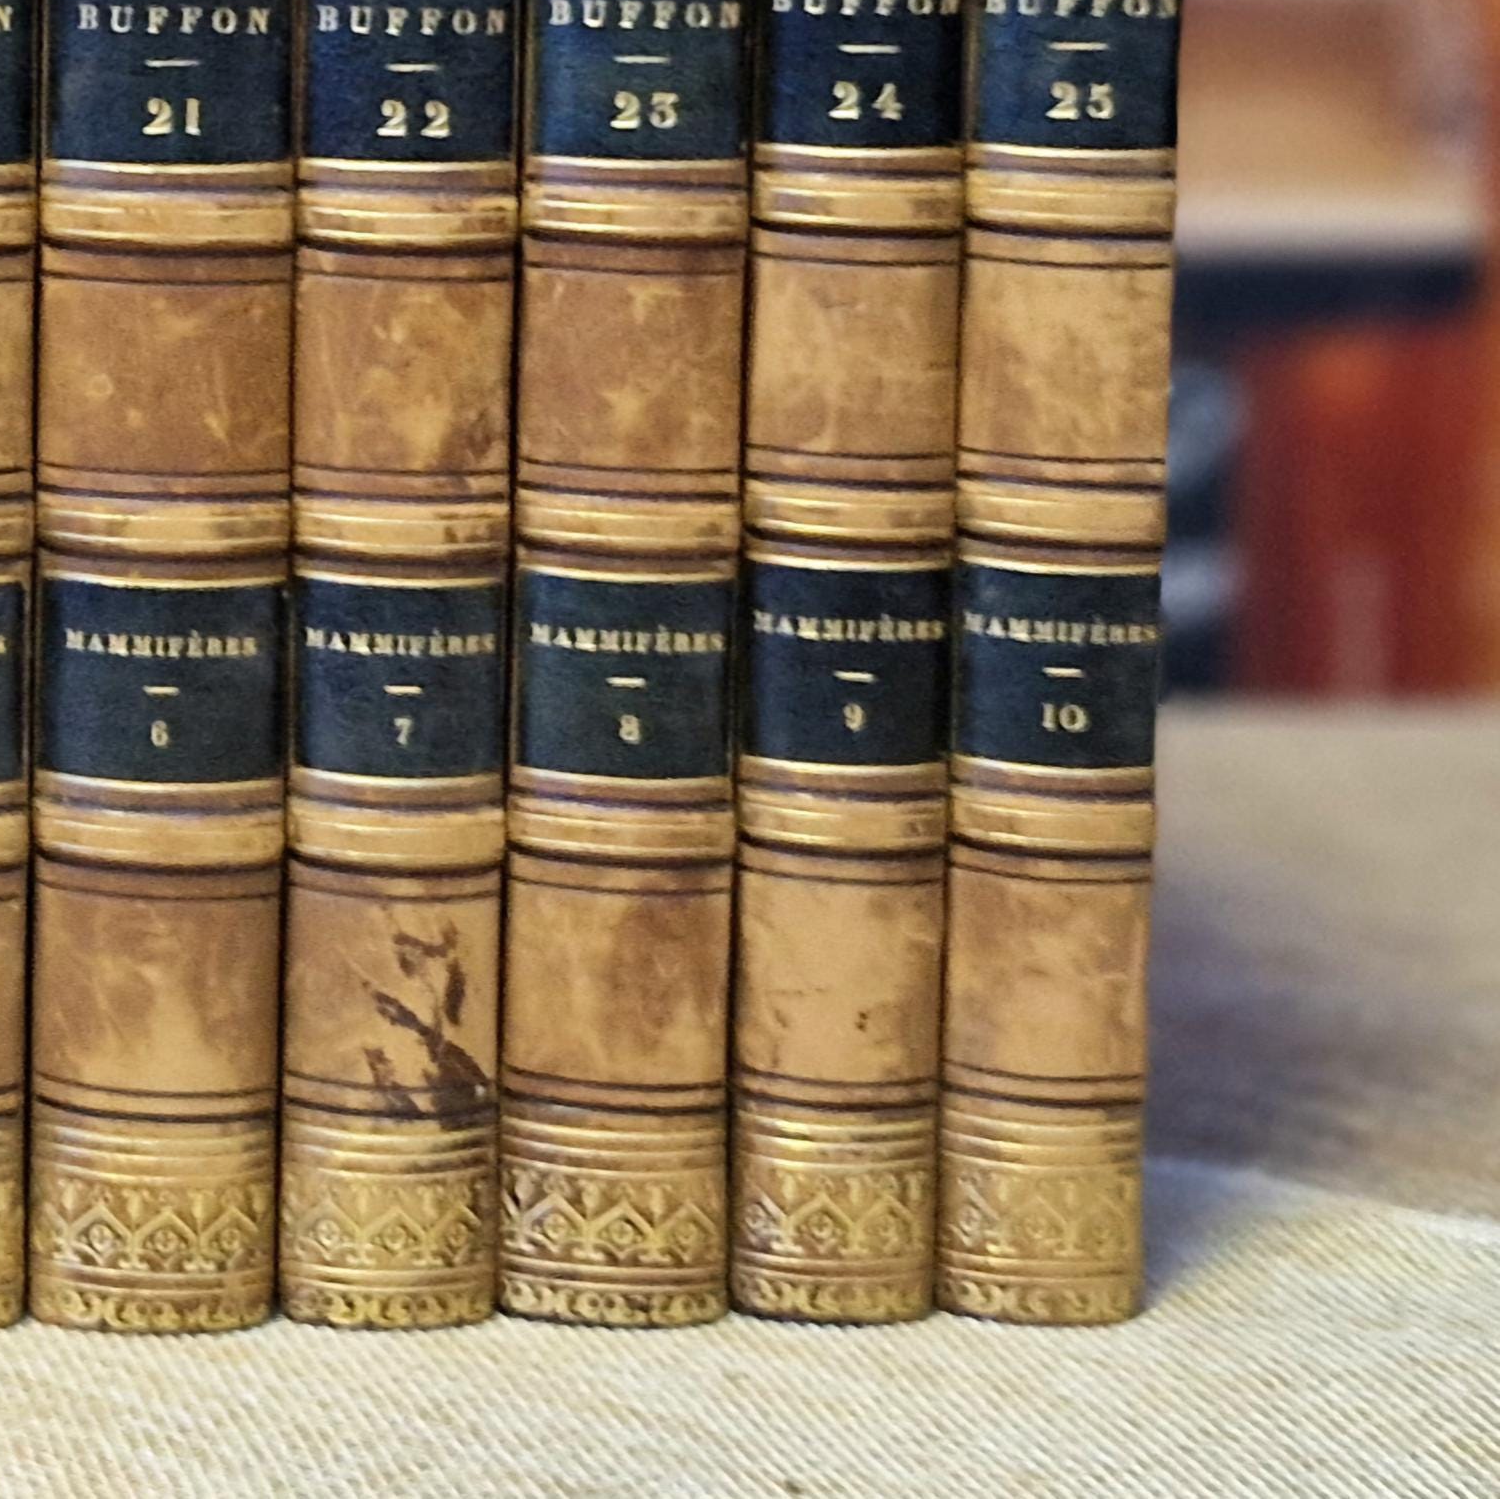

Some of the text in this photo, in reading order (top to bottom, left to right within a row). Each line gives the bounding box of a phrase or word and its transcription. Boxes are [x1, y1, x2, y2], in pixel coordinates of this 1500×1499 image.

[78, 2, 270, 35] BUFFON
[317, 4, 505, 36] BUFFON
[142, 97, 201, 136] 21
[610, 91, 679, 130] 23
[828, 80, 904, 121] 24
[1045, 81, 1115, 120] 25
[377, 99, 451, 138] 22
[150, 720, 170, 748] 6
[395, 716, 413, 746] 7
[619, 714, 642, 745] 8
[843, 704, 866, 734] 9
[1042, 704, 1091, 732] 10
